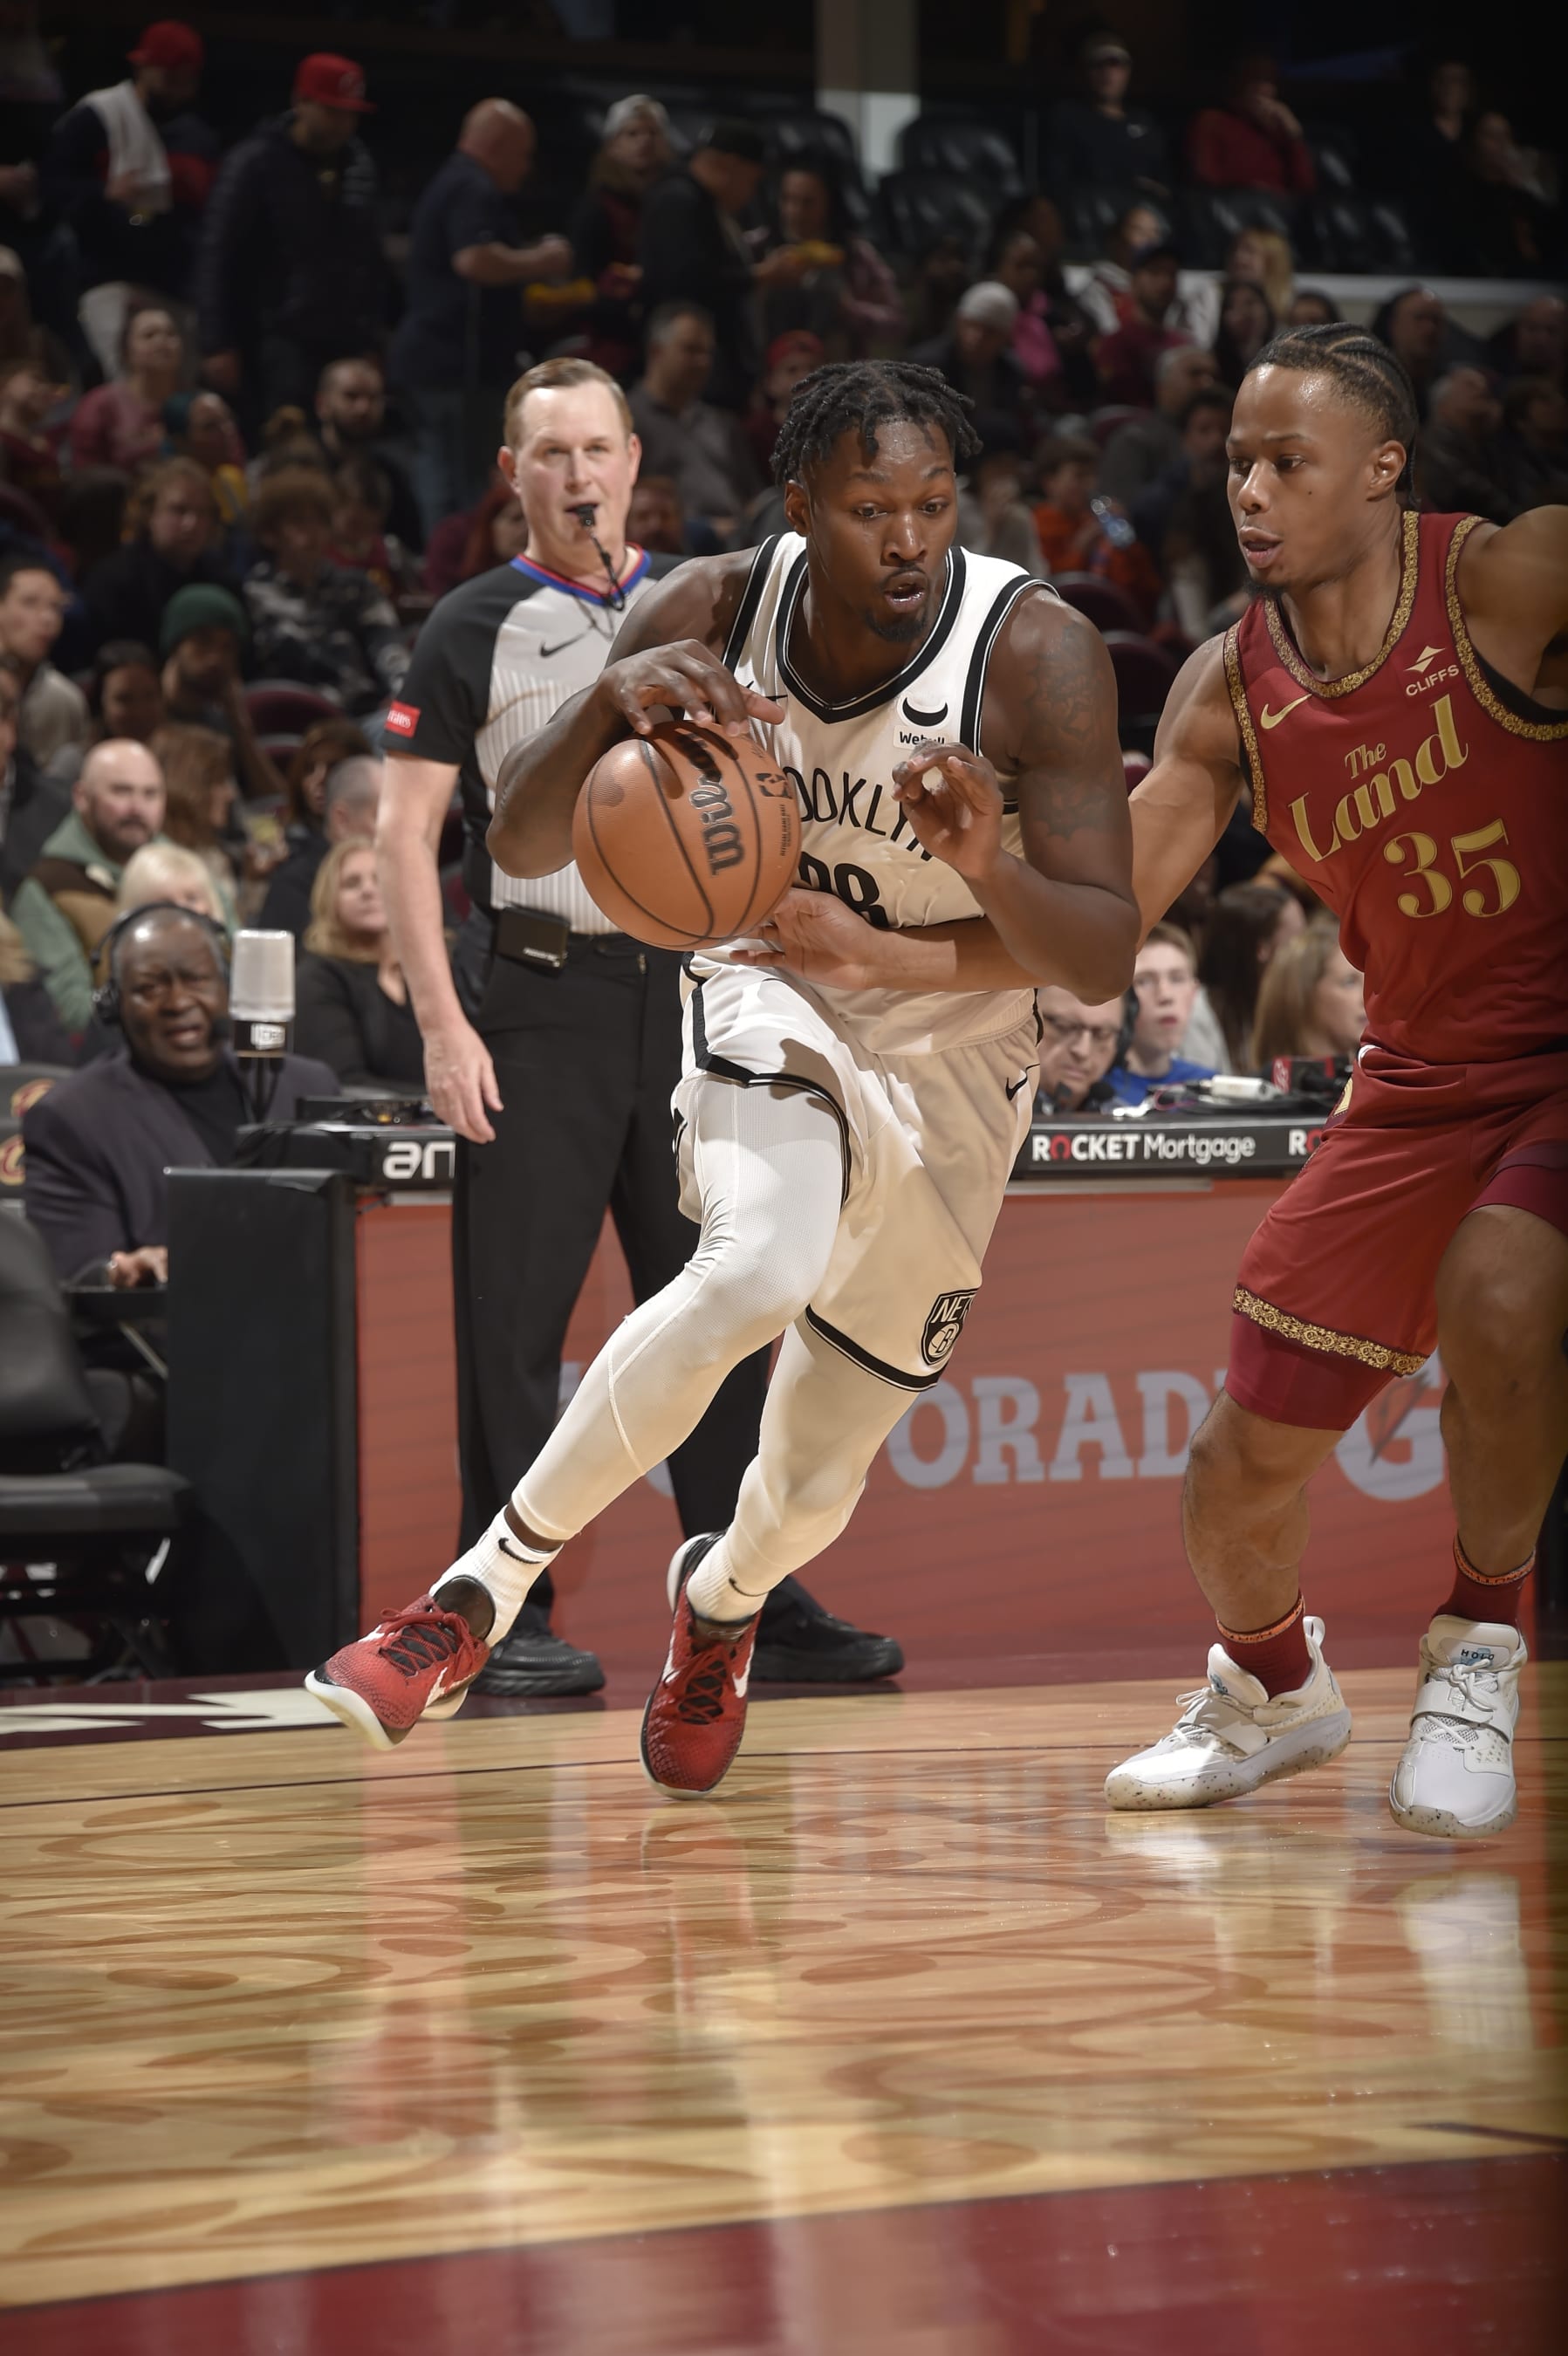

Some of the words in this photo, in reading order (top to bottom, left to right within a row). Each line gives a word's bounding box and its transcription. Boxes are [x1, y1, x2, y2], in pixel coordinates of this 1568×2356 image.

[1406, 664, 1460, 697] CLIFFS
[1288, 694, 1469, 863] Land
[1344, 743, 1387, 780] The
[783, 766, 932, 862] OOKLY
[1384, 818, 1521, 918] 35
[1032, 1133, 1140, 1161] ROCKET
[1144, 1133, 1256, 1164] Mortgage
